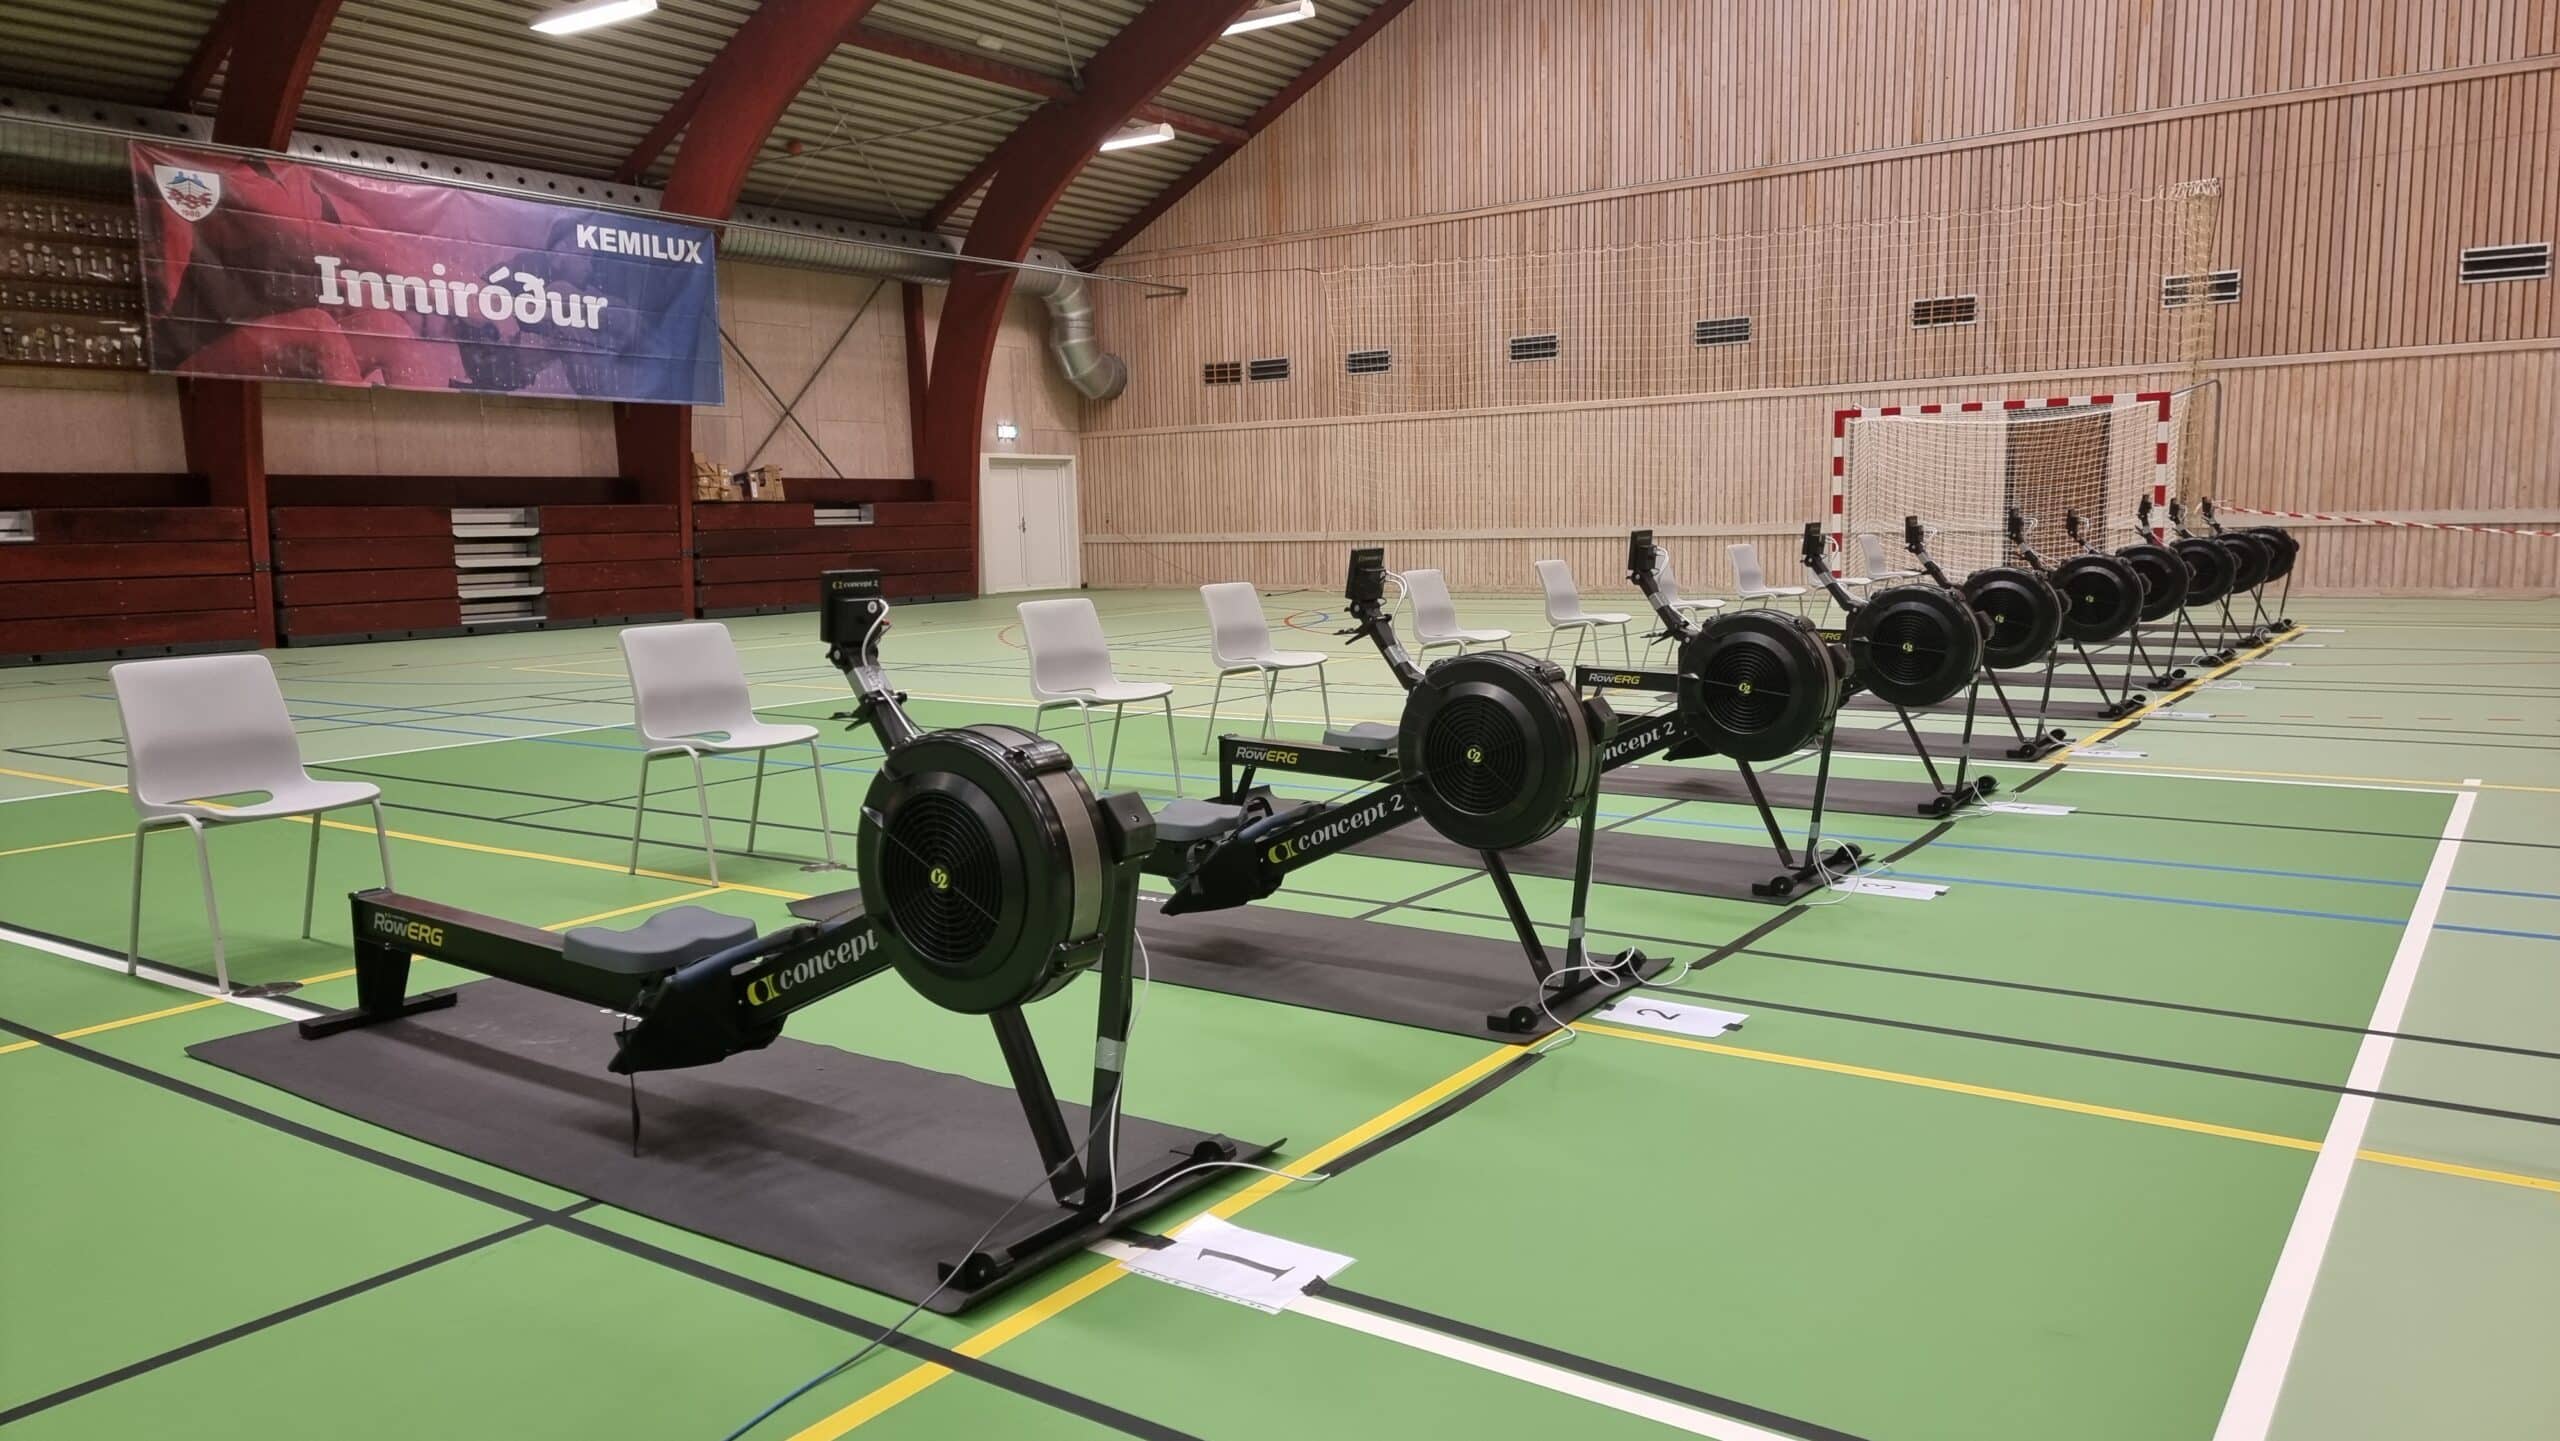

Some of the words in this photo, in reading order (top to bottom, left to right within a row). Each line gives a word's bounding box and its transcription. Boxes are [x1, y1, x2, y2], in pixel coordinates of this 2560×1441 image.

[576, 224, 703, 265] KEMILUX
[314, 255, 608, 330] Inniróður
[1588, 673, 1640, 685] RowERG
[1663, 721, 1676, 736] 2
[1236, 746, 1299, 765] RowERG
[1298, 802, 1388, 851] concept
[1390, 794, 1405, 812] 2
[373, 911, 444, 947] RowERG
[779, 929, 879, 990] concept
[1636, 1008, 1681, 1020] 2
[1197, 1248, 1296, 1281] 1
